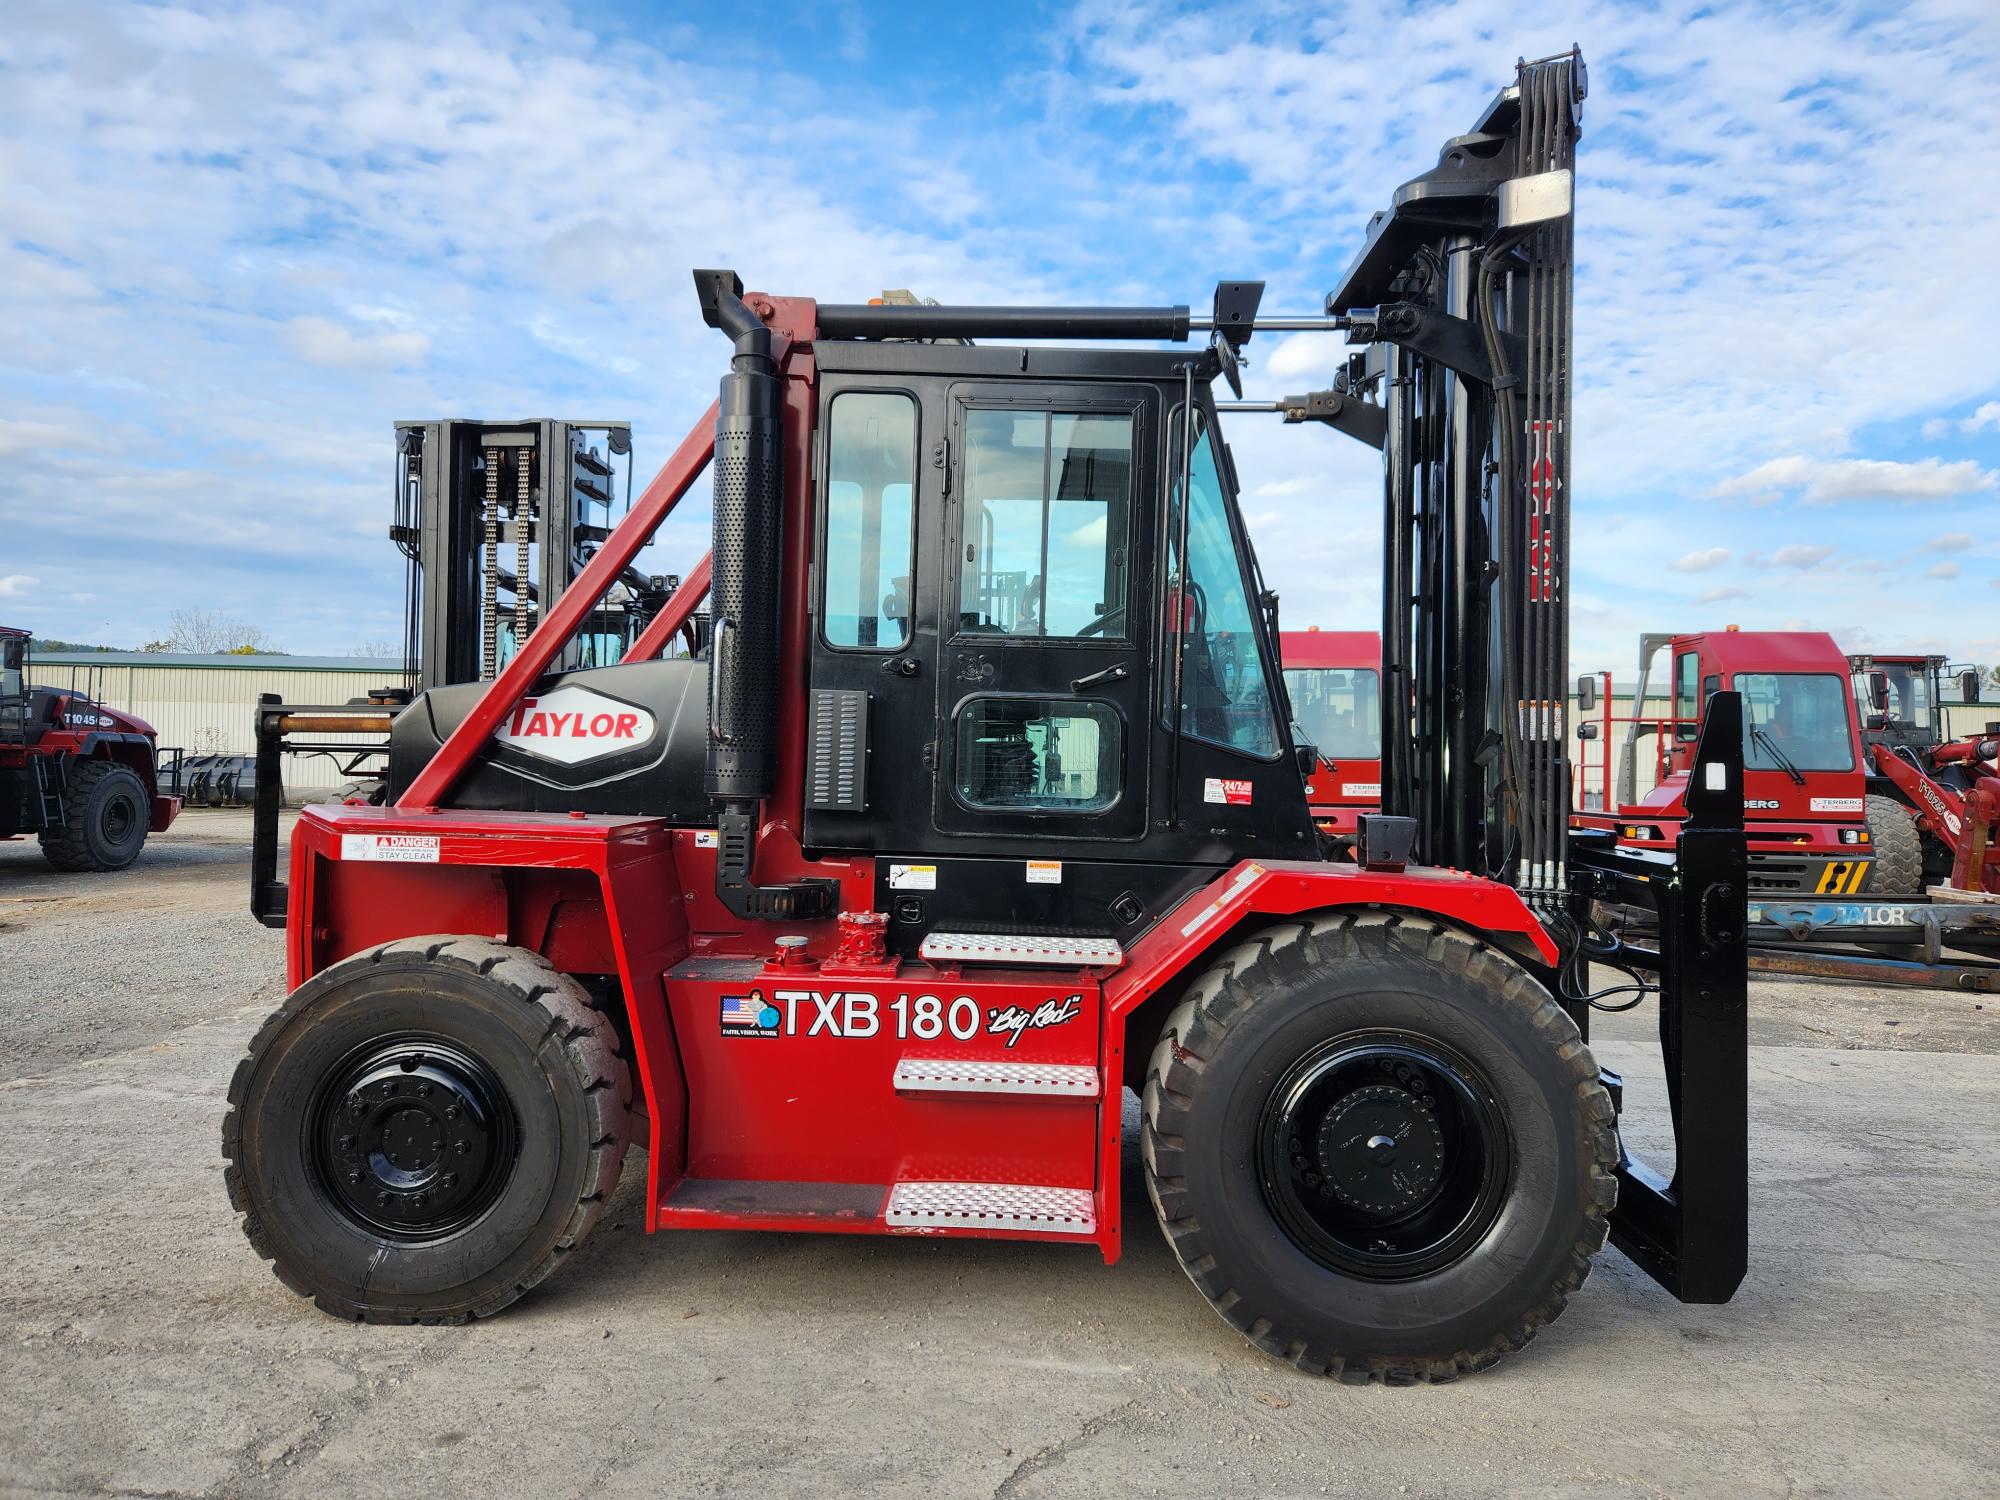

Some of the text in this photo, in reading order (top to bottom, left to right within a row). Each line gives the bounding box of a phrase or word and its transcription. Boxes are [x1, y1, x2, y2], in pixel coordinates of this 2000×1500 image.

[64, 713, 96, 726] T1045
[509, 697, 638, 738] TAYLOR
[1918, 778, 1947, 816] T1025
[390, 837, 437, 848] DANGER
[378, 851, 400, 859] STAY
[1837, 906, 1905, 925] TAYLOR
[773, 990, 981, 1041] TXB 180
